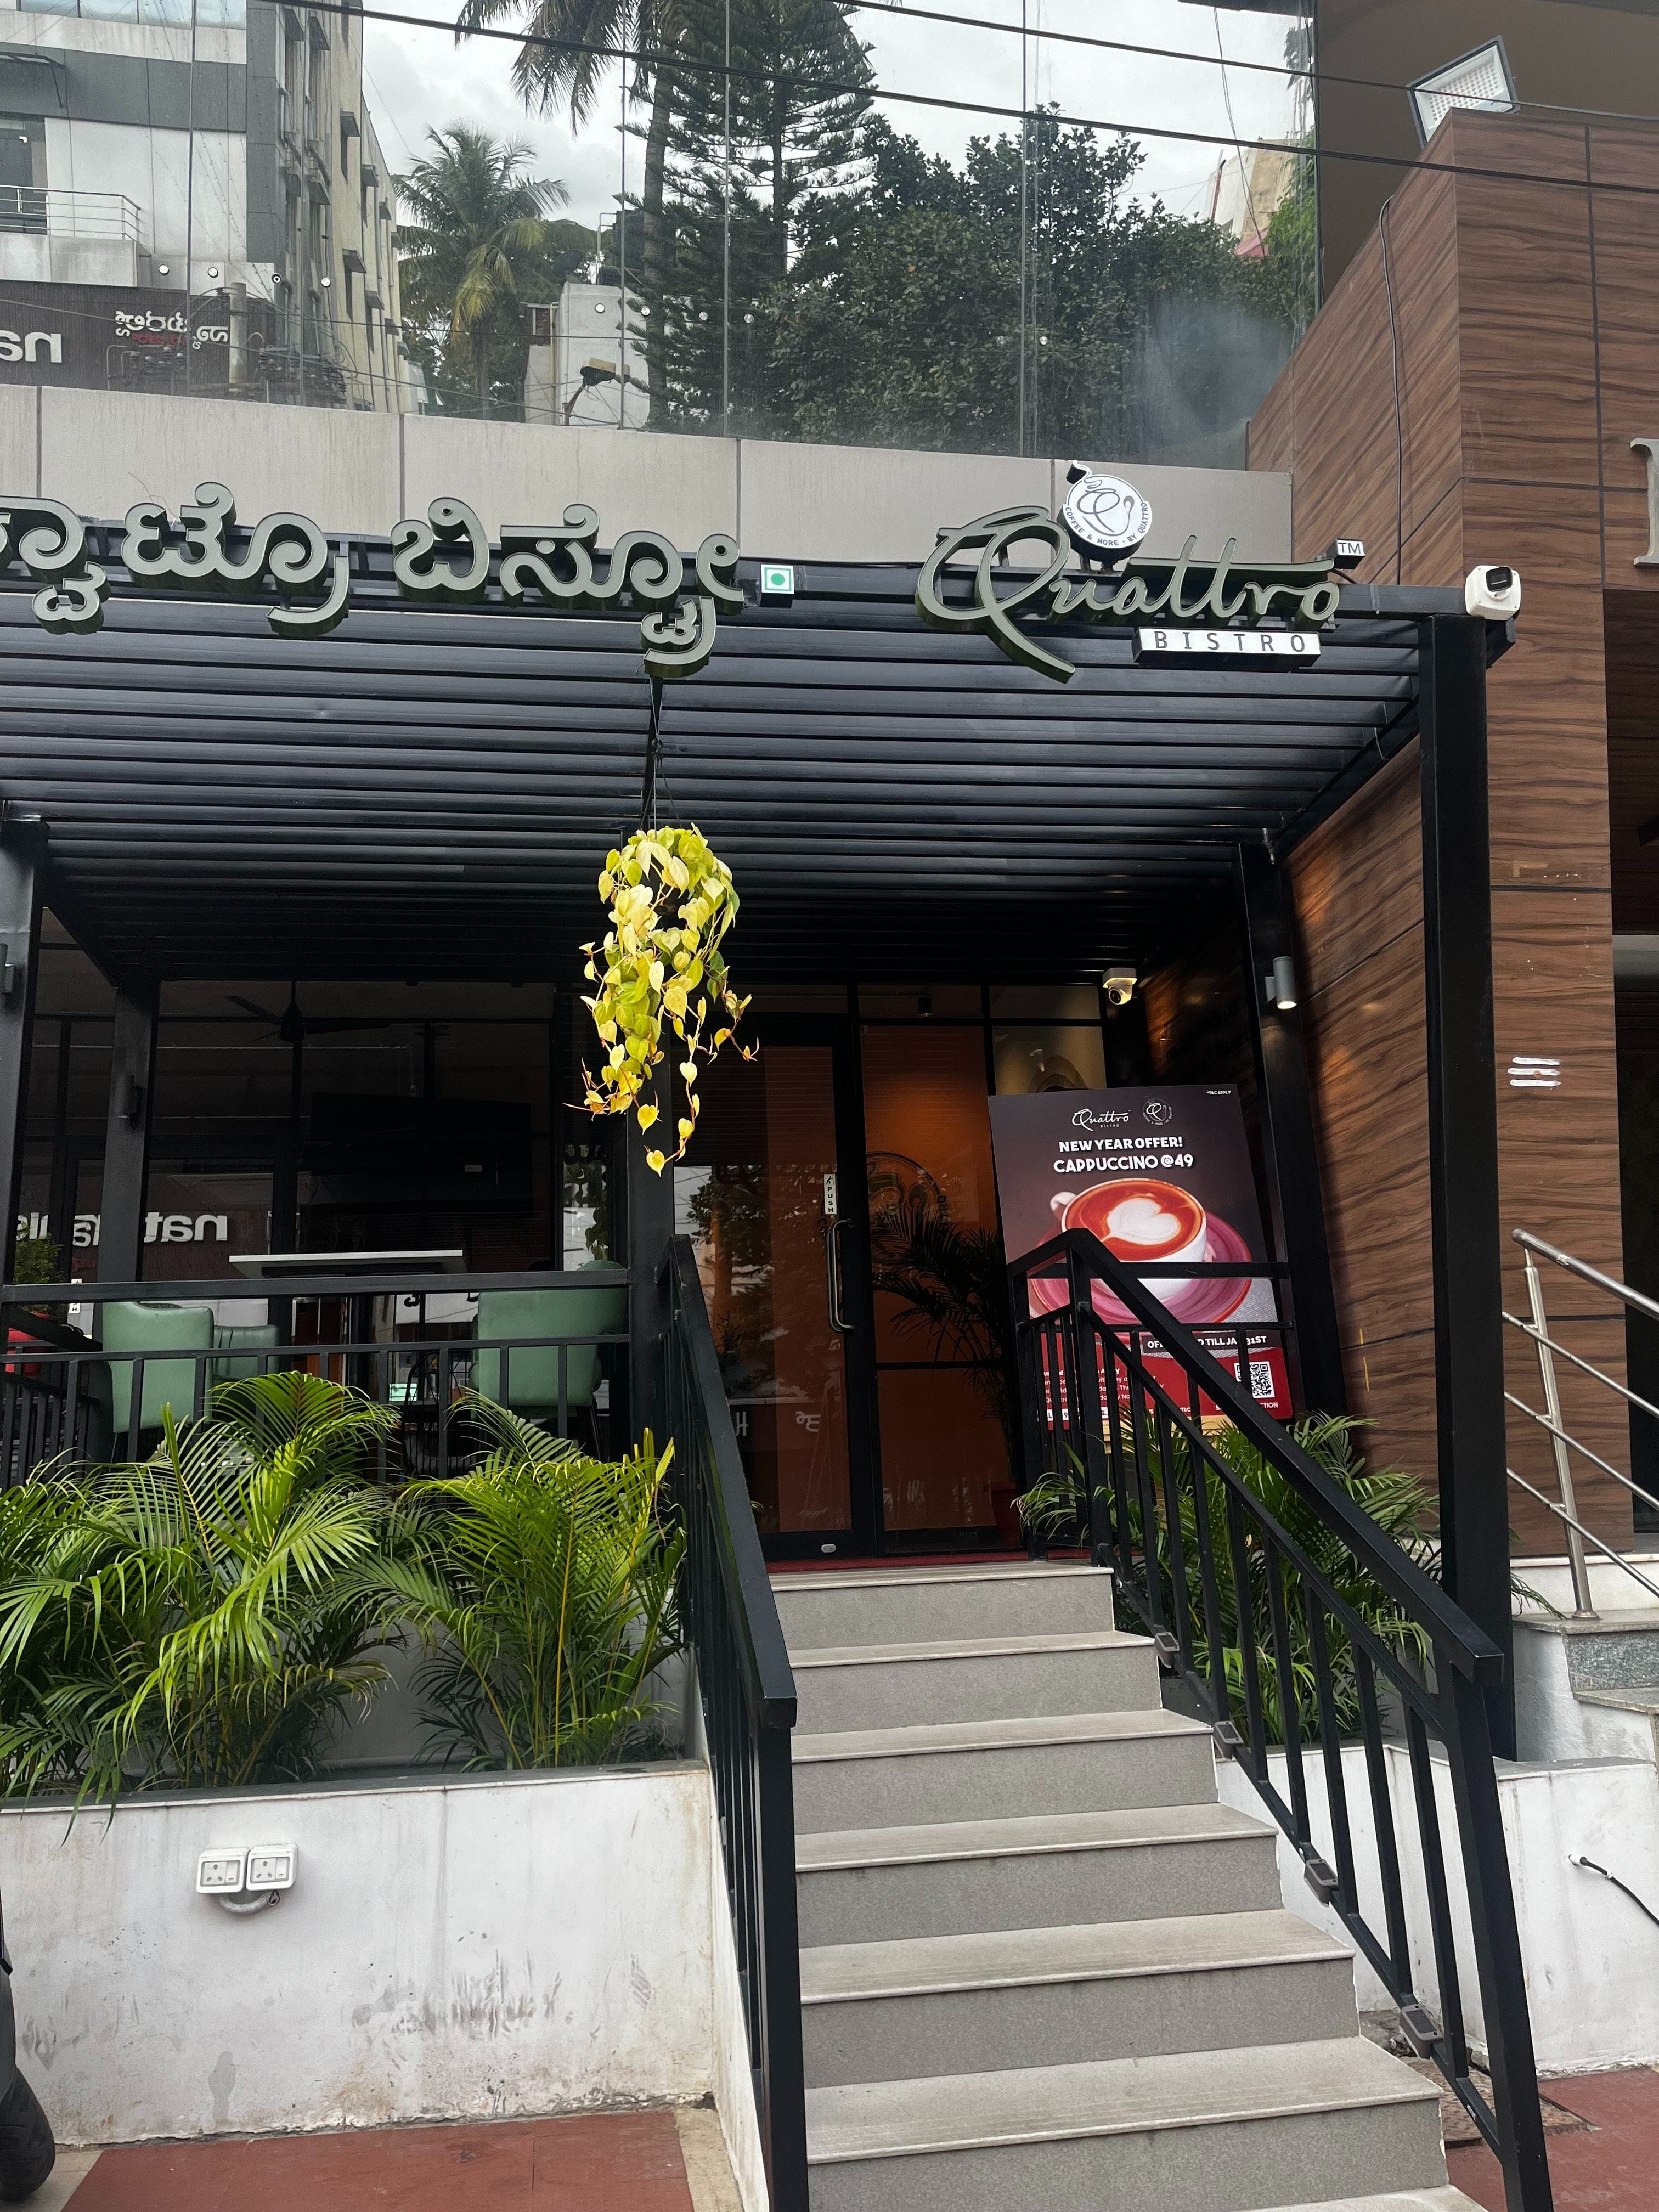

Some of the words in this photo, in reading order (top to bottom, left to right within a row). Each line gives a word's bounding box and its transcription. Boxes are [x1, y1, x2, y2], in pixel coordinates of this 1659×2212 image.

[1065, 507, 1085, 534] COFFEE
[1097, 538, 1119, 546] MORE
[1127, 533, 1137, 543] BY
[1137, 503, 1149, 533] QUATTRO
[915, 506, 1340, 684] Quattro
[1340, 543, 1361, 555] TM
[1155, 632, 1305, 653] BISTRO
[1071, 1108, 1129, 1131] Quattro
[1059, 1140, 1092, 1152] NEW
[1094, 1138, 1133, 1150] YEAR
[1135, 1136, 1183, 1149] OFFER!
[1053, 1155, 1159, 1173] CAPPUCCINO
[1160, 1154, 1194, 1168] @49
[1205, 1338, 1224, 1346] TILL
